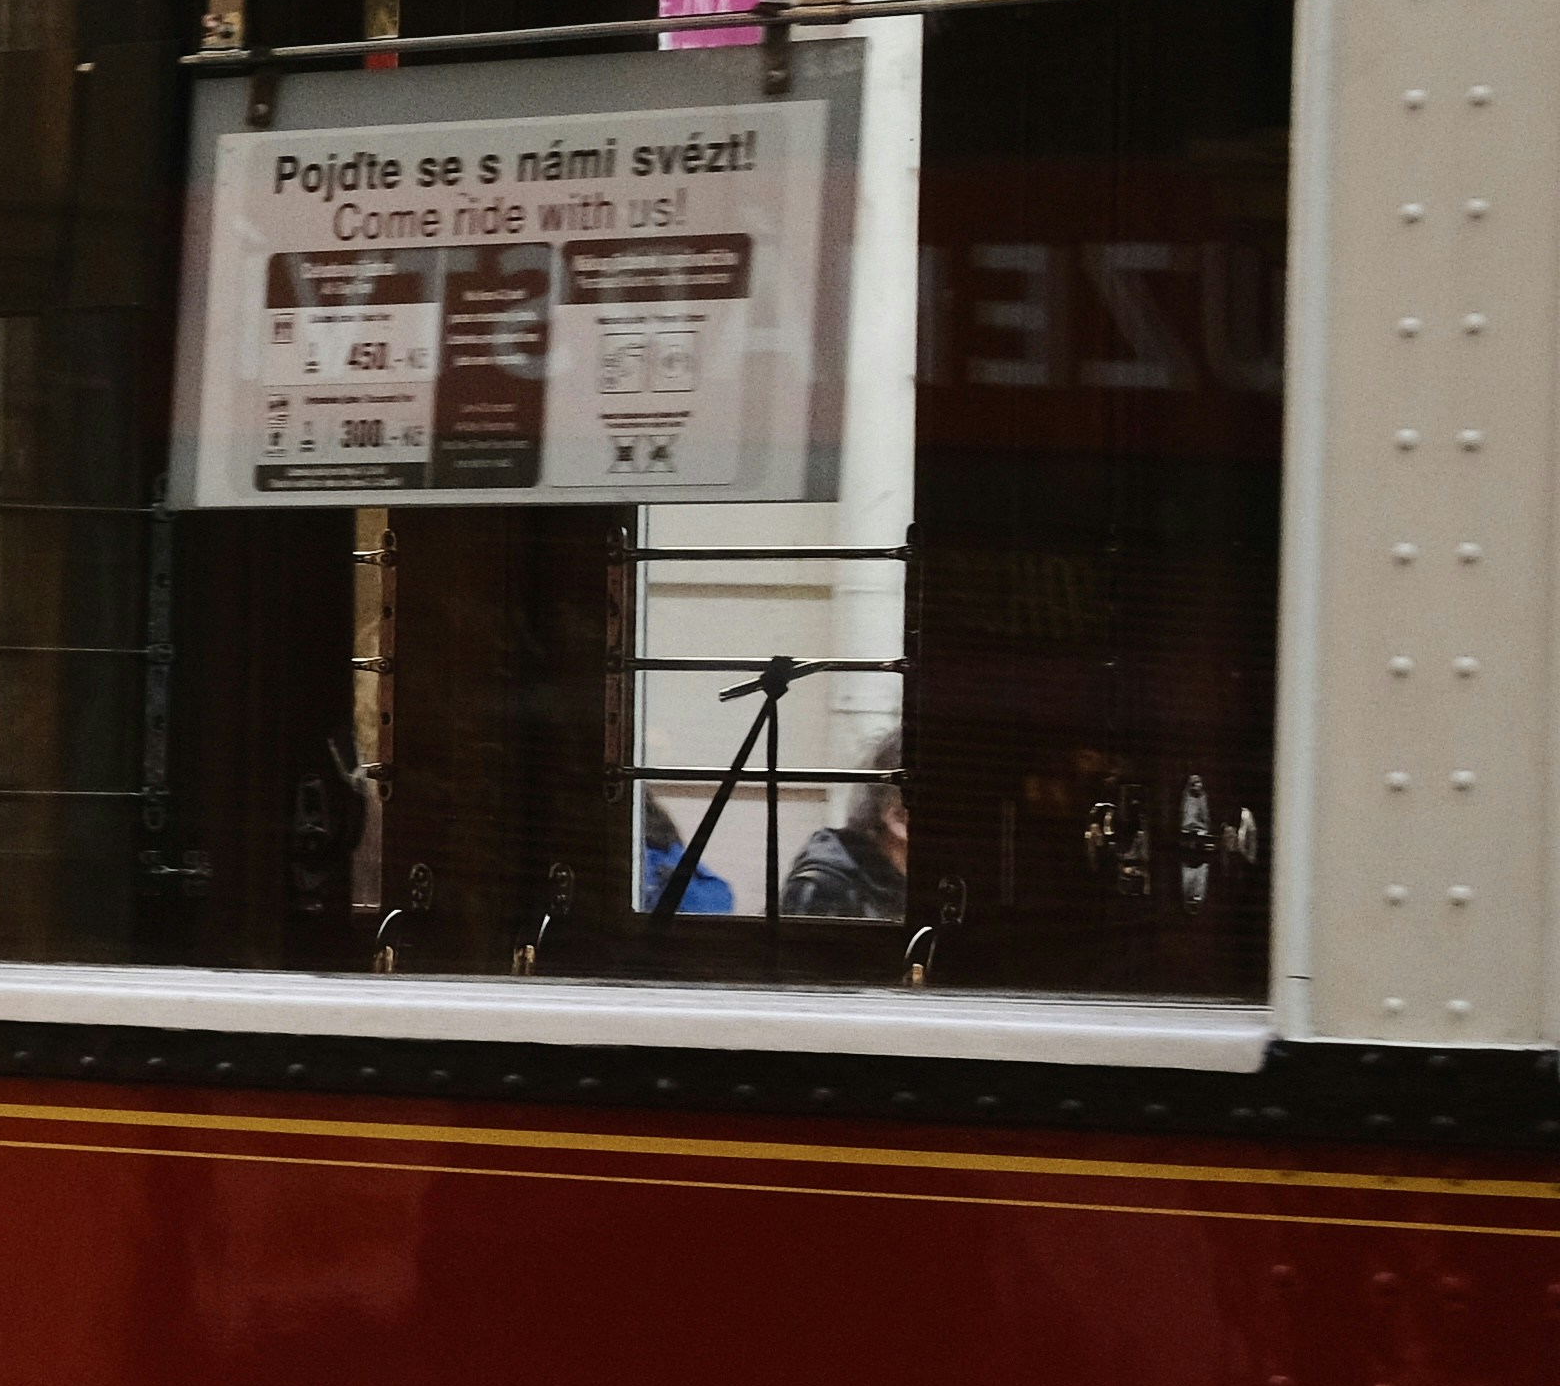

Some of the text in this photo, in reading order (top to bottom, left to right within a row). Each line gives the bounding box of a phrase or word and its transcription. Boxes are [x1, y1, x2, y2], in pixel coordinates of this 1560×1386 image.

[274, 131, 757, 202] Pojďte se s námi svézt!
[333, 188, 688, 242] Come ride with us!
